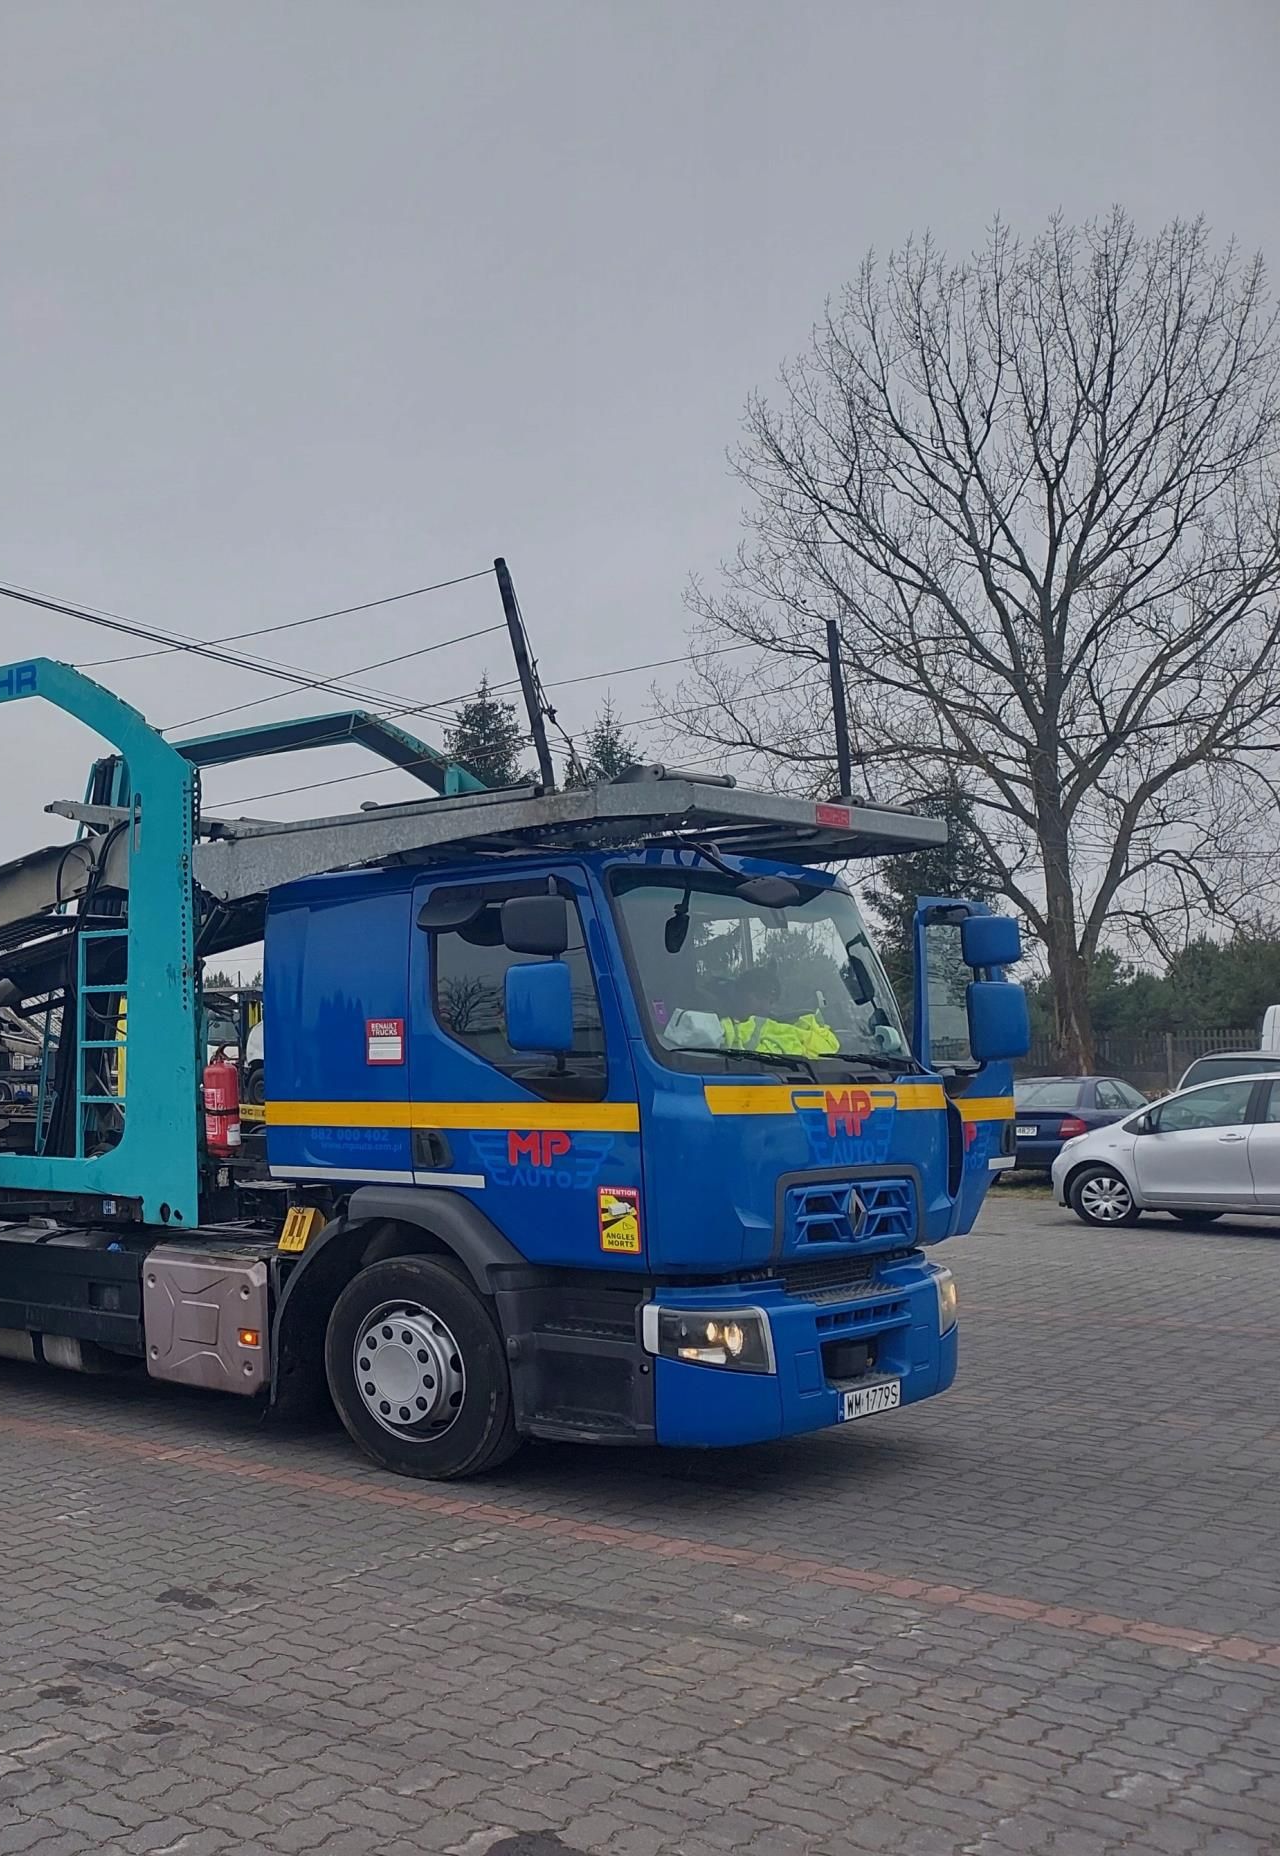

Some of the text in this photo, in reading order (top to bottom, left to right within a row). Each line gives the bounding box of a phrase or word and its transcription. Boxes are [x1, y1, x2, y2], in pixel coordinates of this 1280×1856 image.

[371, 1022, 398, 1030] RENAULT
[825, 1090, 871, 1137] MP
[364, 1129, 390, 1142] 402
[507, 1129, 571, 1168] MP
[831, 1141, 875, 1164] AUTO
[511, 1168, 572, 1188] AUTO
[600, 1188, 638, 1196] ATTENTION
[606, 1232, 635, 1241] ANGLES
[608, 1239, 634, 1248] MORTS
[847, 1384, 898, 1417] WM 1779S
